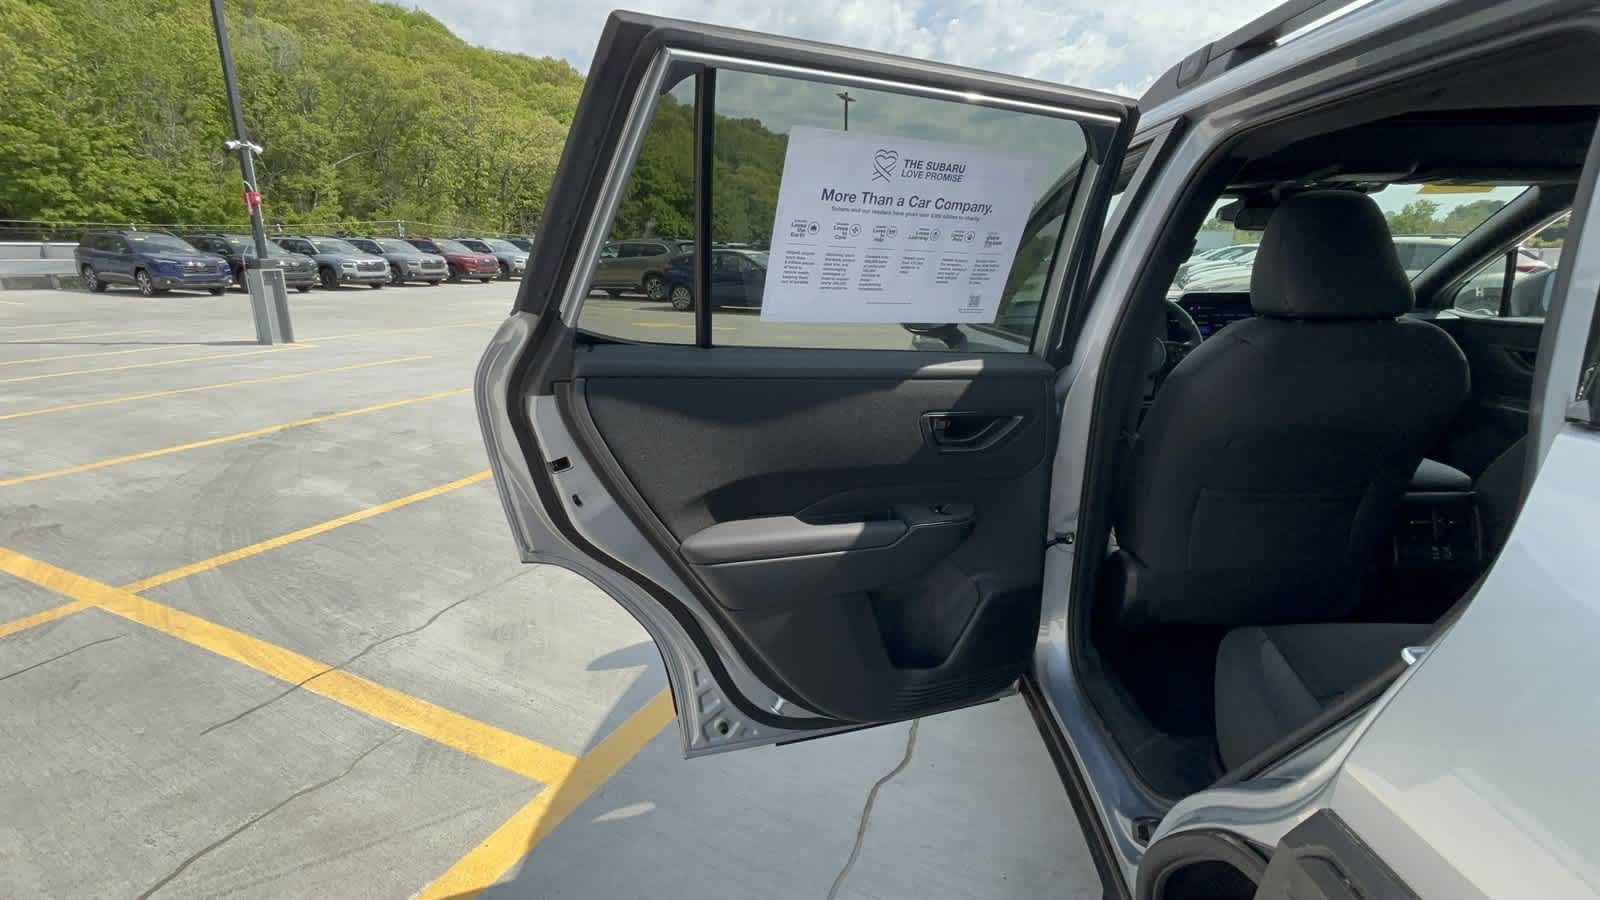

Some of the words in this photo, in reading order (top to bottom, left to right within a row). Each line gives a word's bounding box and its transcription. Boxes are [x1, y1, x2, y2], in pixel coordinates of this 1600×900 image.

[904, 159, 923, 170] THE
[926, 161, 966, 174] SUBARU
[901, 169, 923, 179] LOVE
[925, 172, 963, 183] PROMISE
[821, 187, 857, 203] More
[861, 191, 893, 207] Than
[896, 196, 905, 207] a
[908, 195, 931, 210] Car
[935, 197, 993, 215] Company.
